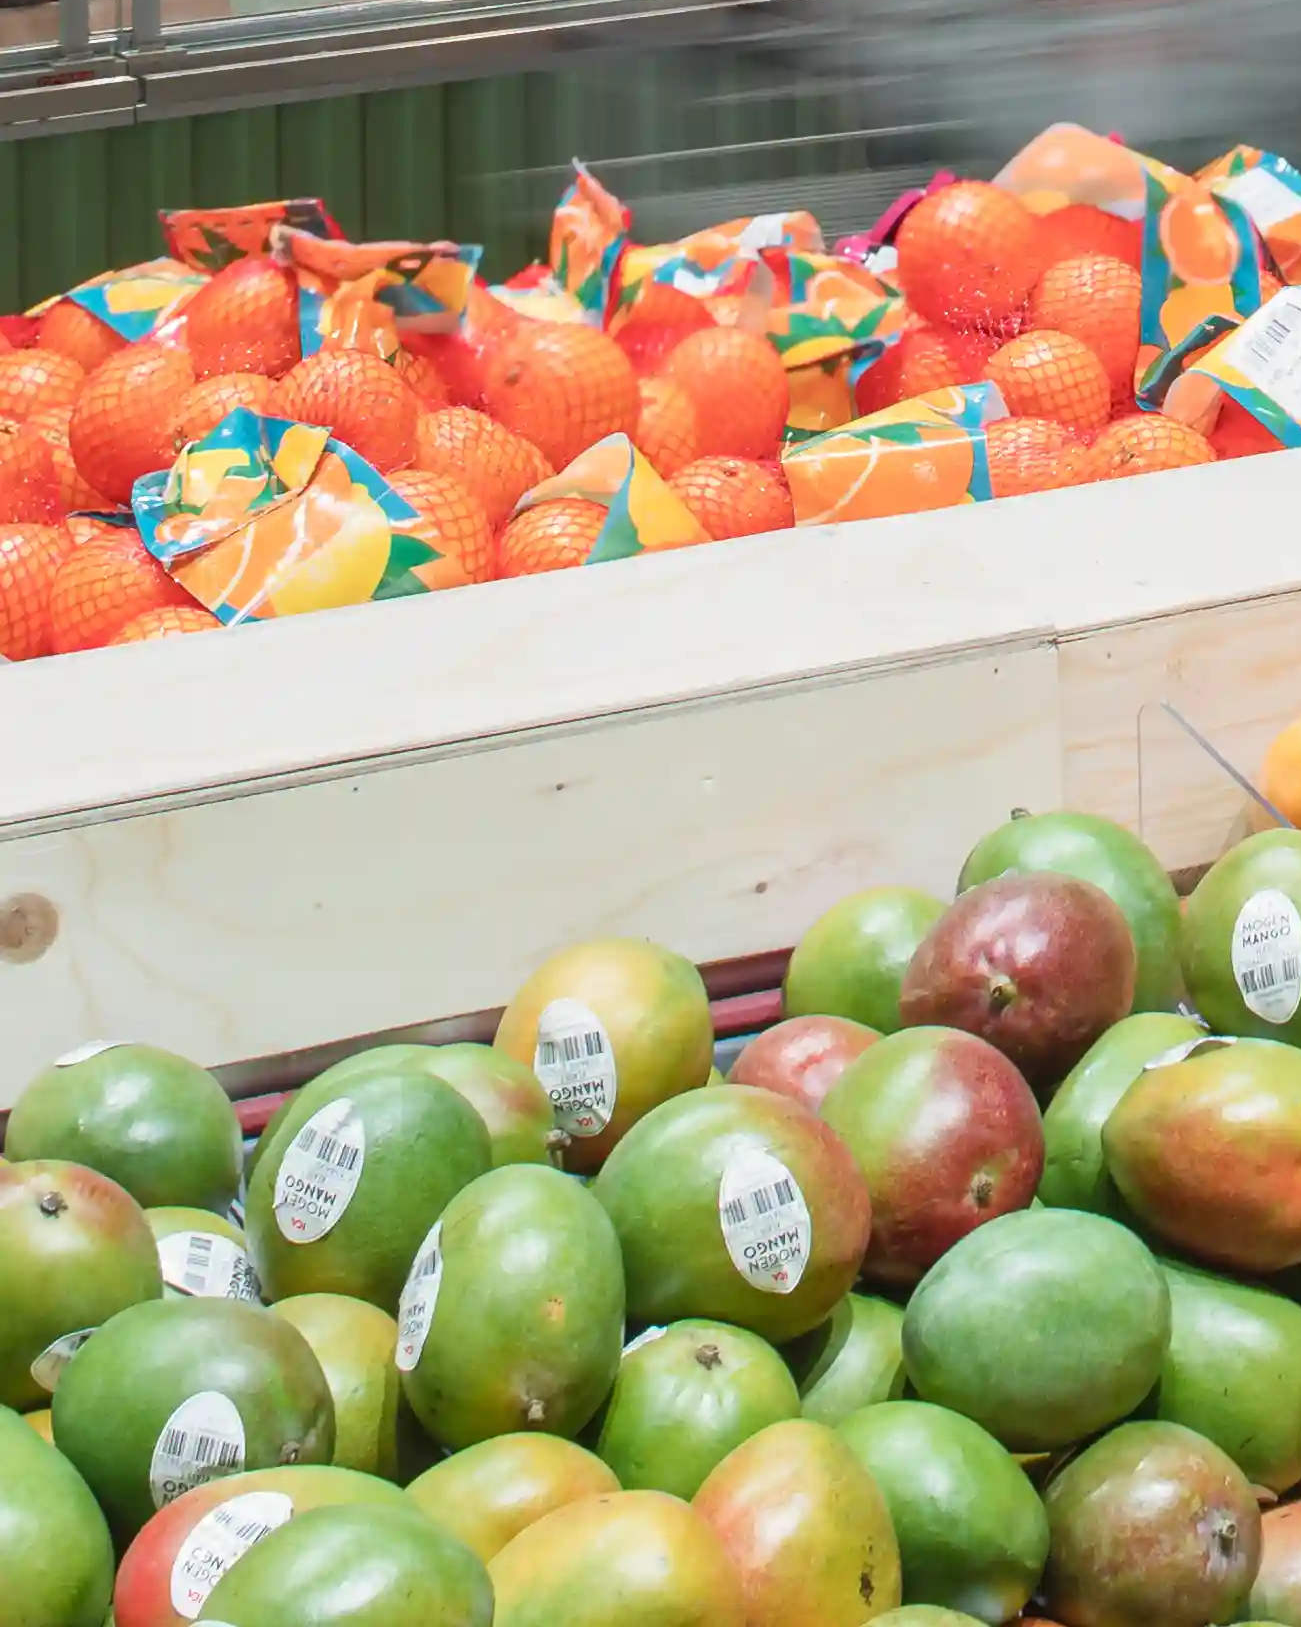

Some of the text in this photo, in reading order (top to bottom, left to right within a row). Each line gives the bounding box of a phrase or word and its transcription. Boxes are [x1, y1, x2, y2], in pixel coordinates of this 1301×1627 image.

[1242, 926, 1291, 948] MANGO
[549, 1079, 605, 1103] MANGO
[285, 1174, 337, 1206] MANGO
[291, 1216, 307, 1231] ICA
[743, 1226, 800, 1259] MANGO
[749, 1242, 802, 1274] MOGEN
[182, 1560, 221, 1587] OGEN
